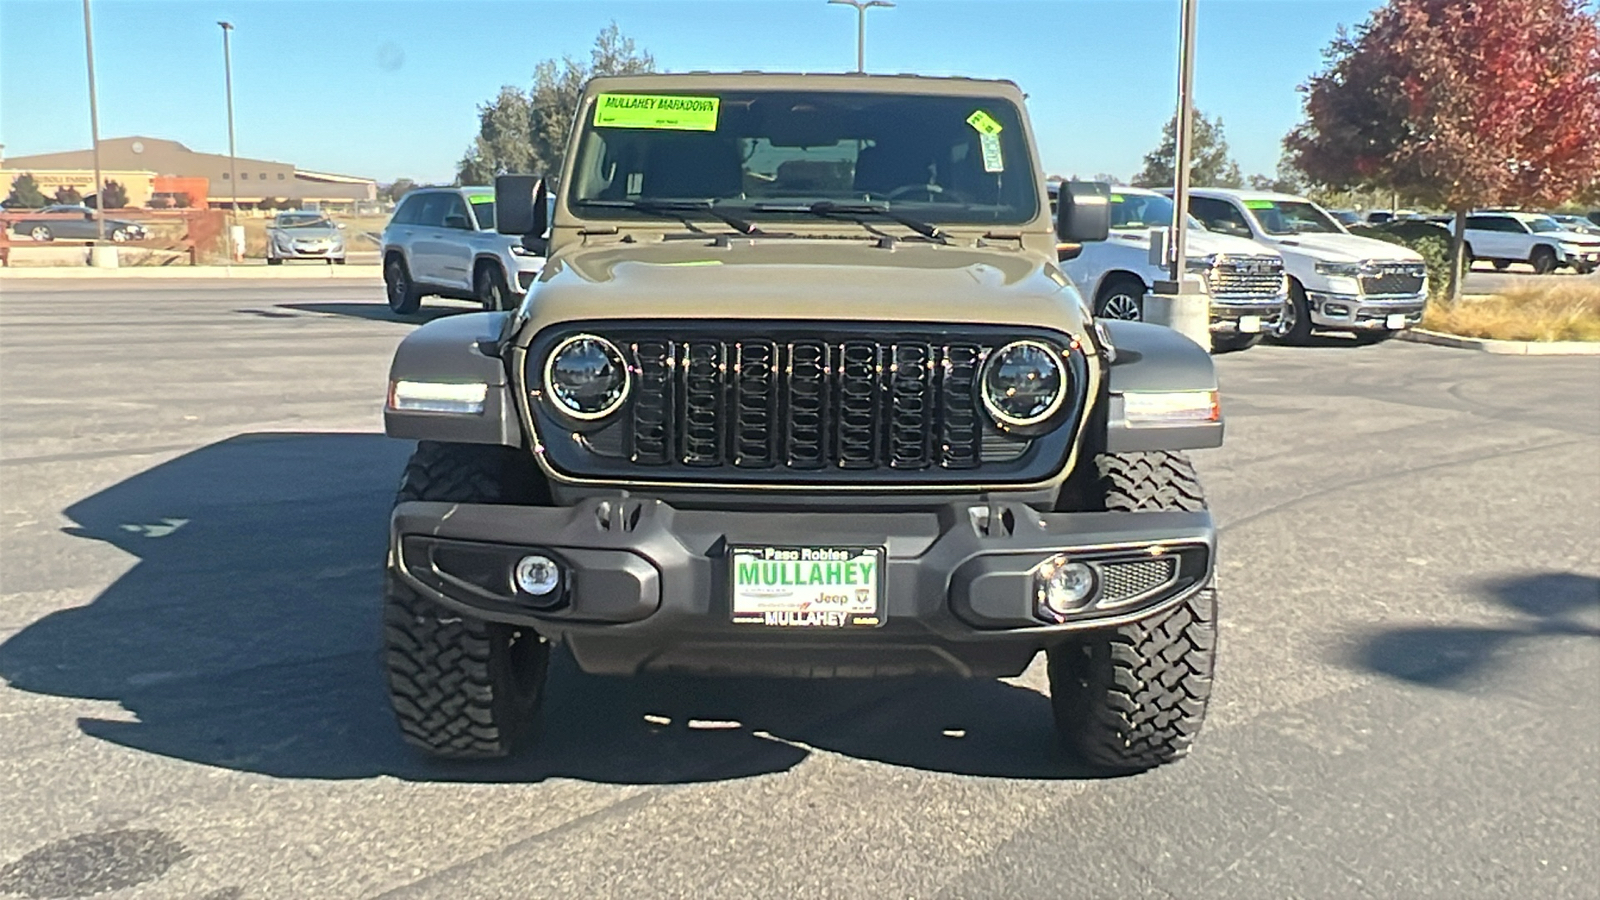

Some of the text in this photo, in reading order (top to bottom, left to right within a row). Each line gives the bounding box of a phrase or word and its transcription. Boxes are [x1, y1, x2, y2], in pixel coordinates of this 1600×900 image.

[605, 97, 715, 111] MULLAHEY MARKDOWN
[765, 548, 848, 561] Paso Robles
[739, 562, 874, 585] MULLAHEY
[815, 592, 849, 606] Jeep
[765, 611, 848, 627] MULLAHEY
